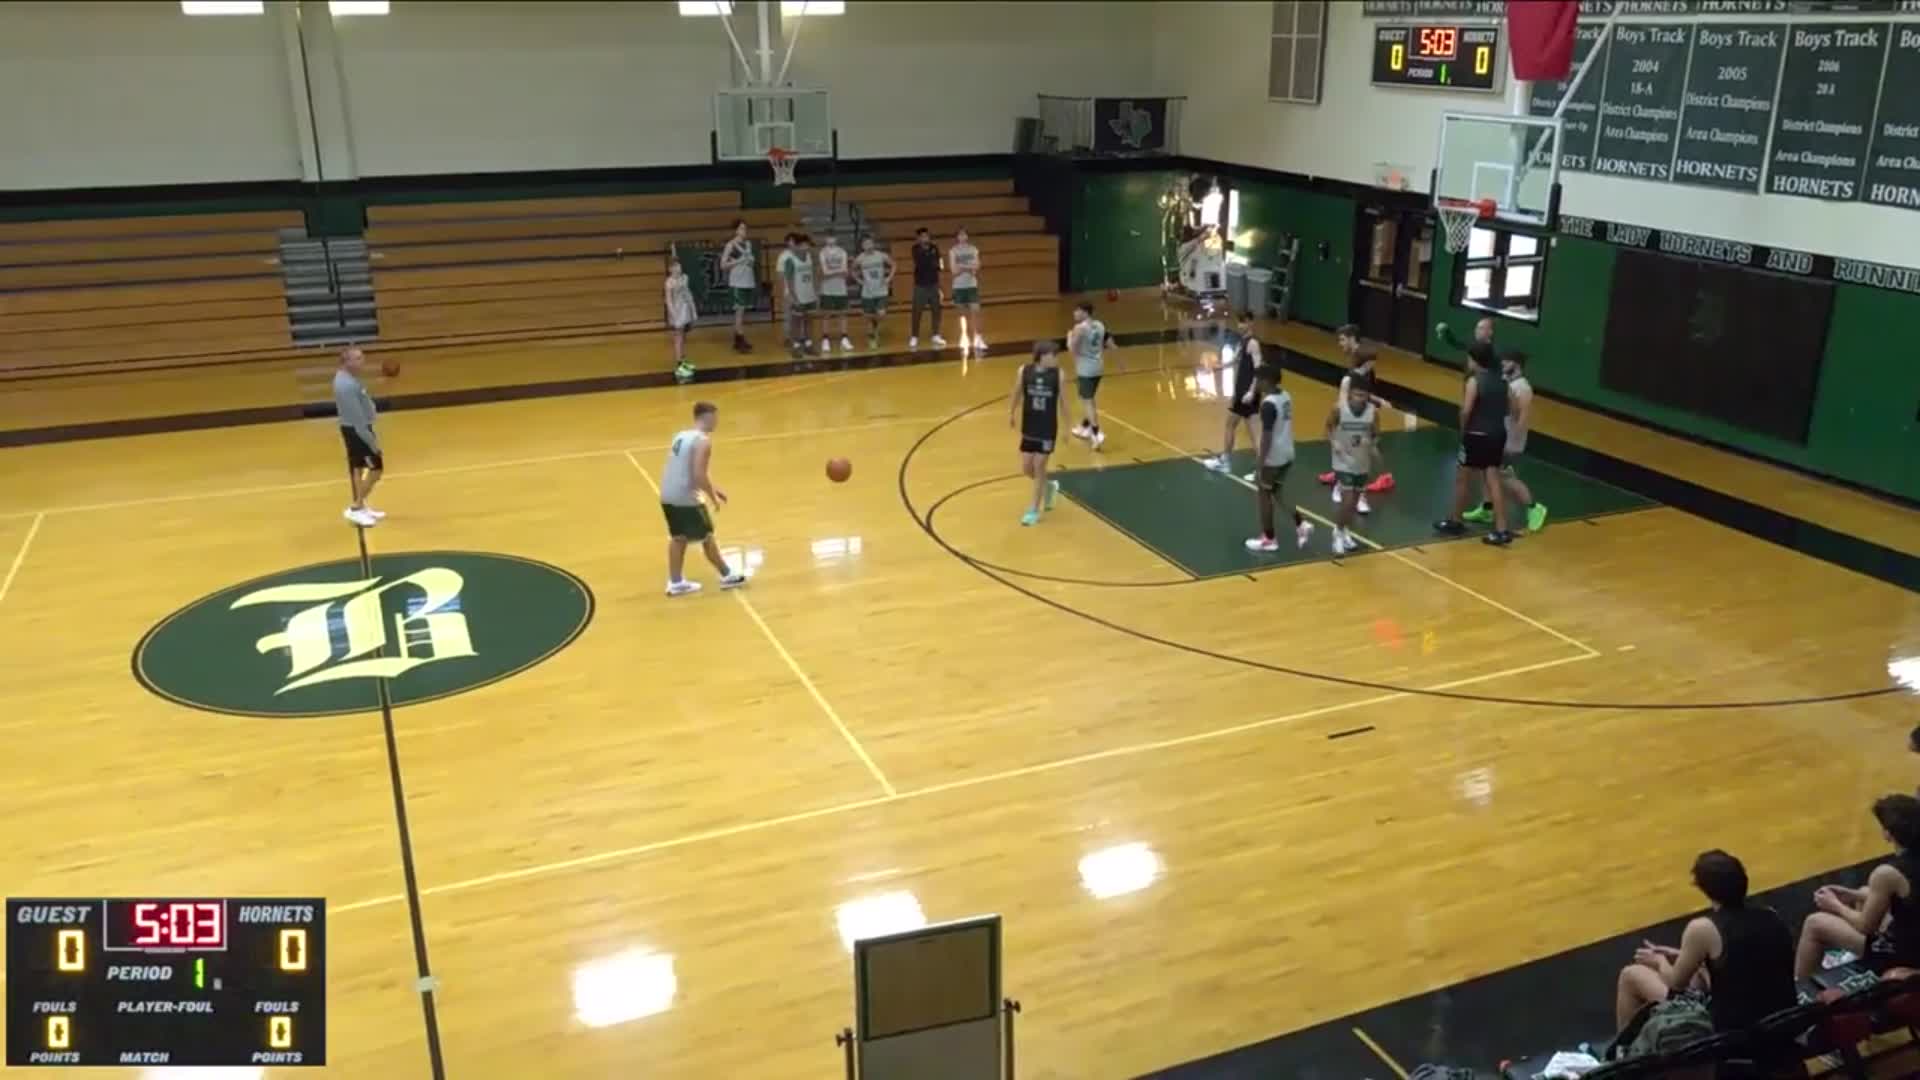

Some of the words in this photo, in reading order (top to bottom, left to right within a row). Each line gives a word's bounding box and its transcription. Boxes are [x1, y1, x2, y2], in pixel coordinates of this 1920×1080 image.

[1621, 0, 1688, 12] HORNETS
[1701, 0, 1785, 11] HORNETS
[1420, 28, 1456, 55] 5:03
[1616, 26, 1646, 44] Boys
[1651, 27, 1685, 43] Track
[1699, 30, 1732, 48] Boys
[1739, 31, 1777, 48] Track
[1795, 31, 1831, 50] Boys
[1836, 29, 1878, 47] Track
[1900, 30, 1920, 52] Bo
[1390, 44, 1403, 70] 0
[1475, 46, 1489, 74] 0
[1632, 60, 1659, 73] 2004
[1717, 66, 1747, 81] 2005
[1602, 102, 1631, 117] District
[1632, 104, 1677, 121] Champions
[1686, 92, 1718, 107] District
[1721, 94, 1771, 112] Champions
[1604, 125, 1624, 138] Area
[1625, 127, 1668, 143] Champions
[1687, 127, 1708, 141] Area
[1710, 128, 1758, 146] Champions
[1782, 118, 1815, 132] District
[1816, 121, 1862, 136] Champions
[1597, 157, 1668, 177] HORNETS
[1776, 149, 1799, 163] Area
[1801, 151, 1856, 168] Champions
[1876, 154, 1901, 168] Area
[1677, 160, 1758, 183] HORNETS
[1773, 175, 1854, 198] HORNETS
[1560, 215, 1594, 238] THE
[1606, 223, 1652, 248] LADY
[1659, 231, 1753, 264] HORNETS
[1766, 249, 1813, 275] AND
